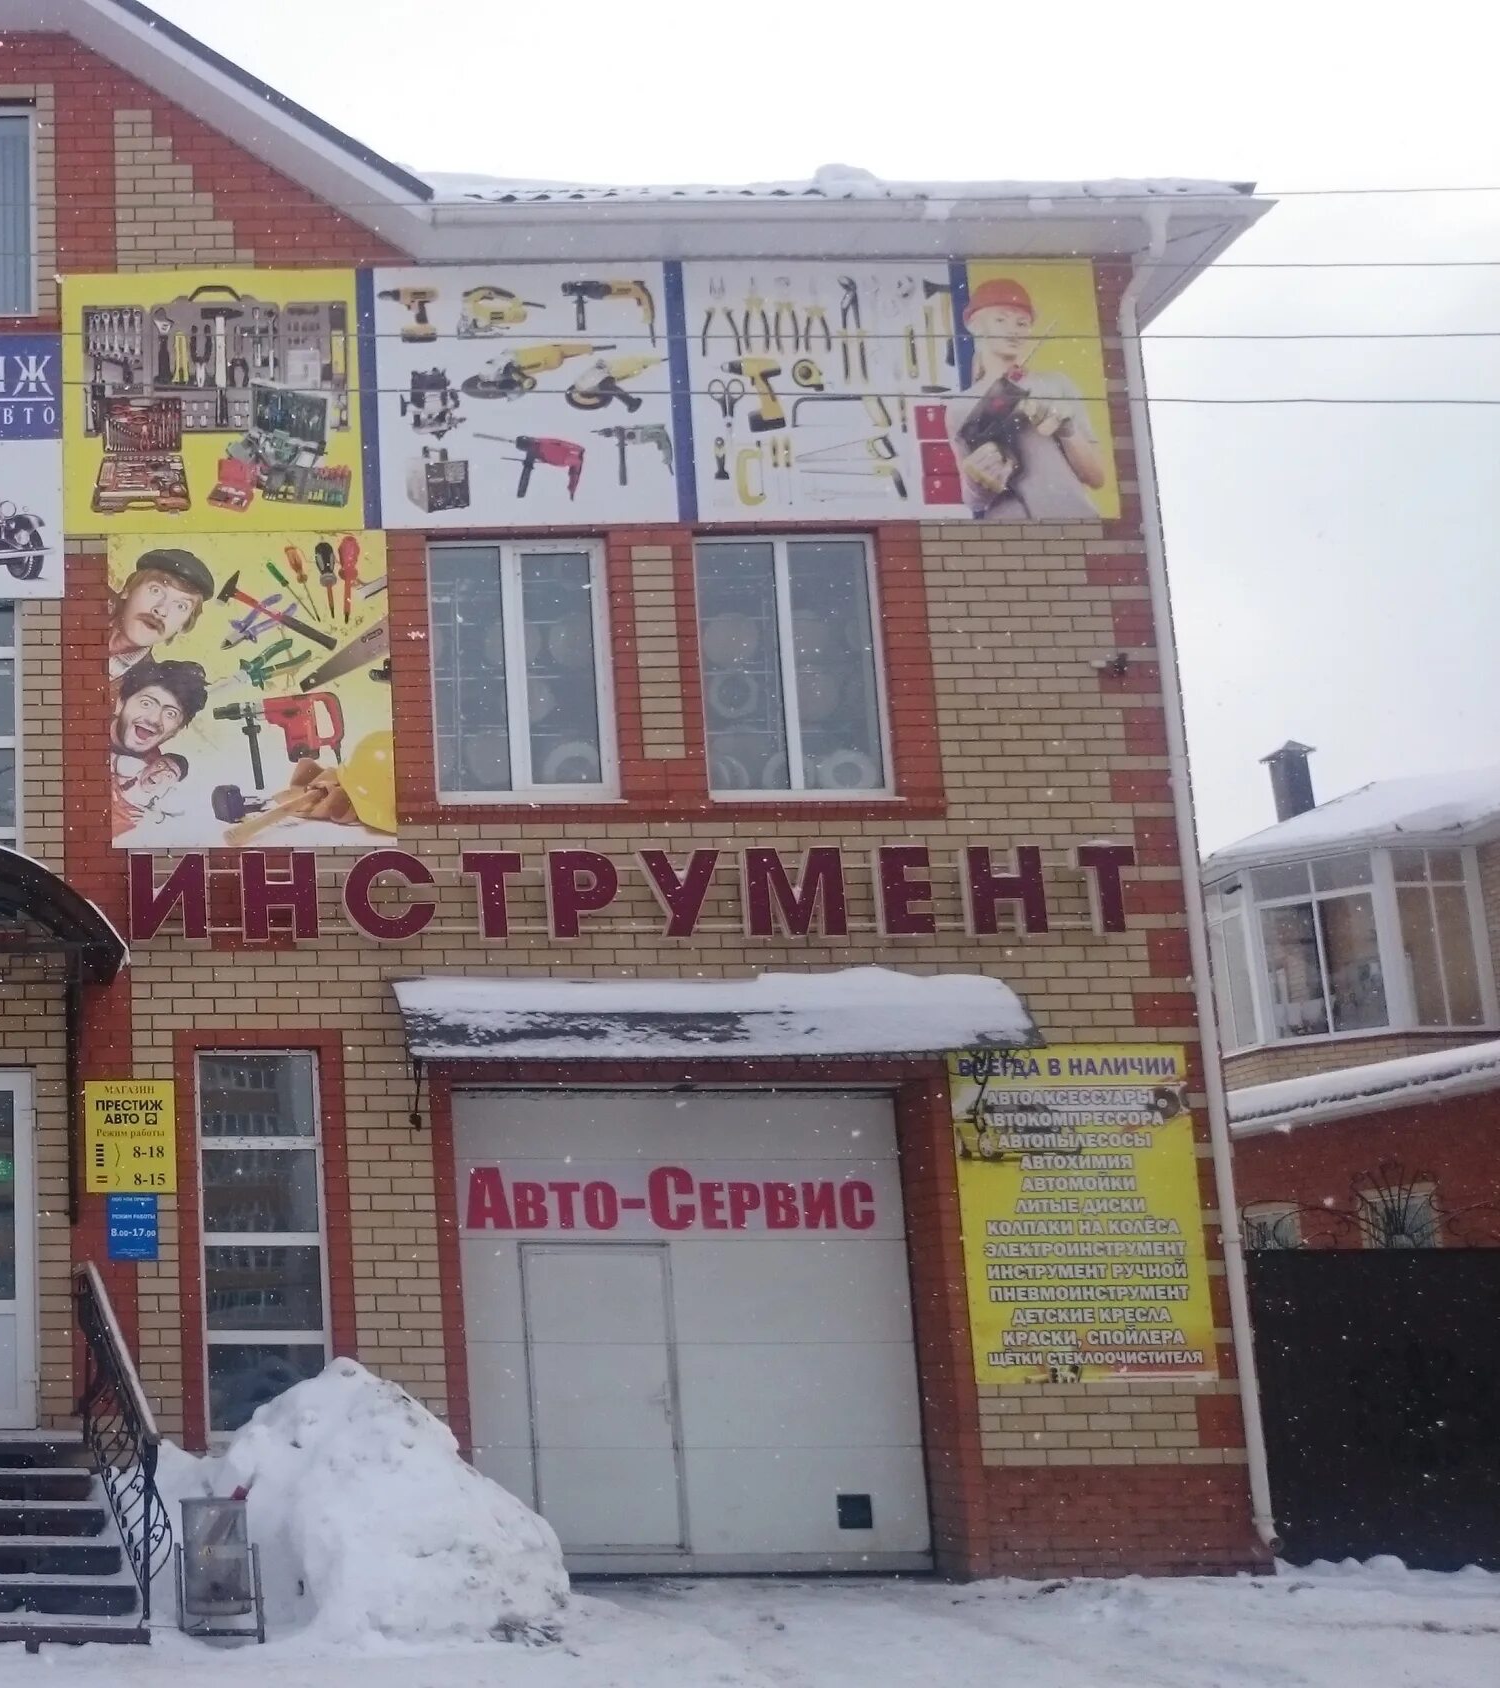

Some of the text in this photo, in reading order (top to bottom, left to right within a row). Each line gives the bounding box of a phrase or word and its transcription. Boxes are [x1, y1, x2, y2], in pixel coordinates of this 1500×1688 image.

[129, 843, 1136, 942] ИНСТРУМЕНТ
[1047, 1057, 1062, 1076] В
[1068, 1057, 1177, 1076] НАЛИЧИИ
[104, 1085, 155, 1094] МАГАЗИН
[986, 1089, 1155, 1106] АВТОАКСЕССУАРЫ
[95, 1099, 164, 1111] ПРЕСТИЖ
[104, 1113, 140, 1125] АВТО
[983, 1111, 1164, 1128] АВТОКОМПРЕССОРА
[96, 1128, 165, 1139] Режим работы
[998, 1132, 1153, 1149] АВТОПЫЛЕСОСЫ
[133, 1145, 165, 1159] 8-18
[1019, 1153, 1134, 1171] АВТОХИМИЯ
[134, 1173, 166, 1186] 8-15
[1021, 1171, 1137, 1193] АВТОМОЙКИ
[1014, 1197, 1147, 1217] ЛИТЫЕ ДИСКИ
[110, 1228, 157, 1238] 8.00-17.00
[986, 1220, 1073, 1237] КОЛПАКИ
[1078, 1219, 1103, 1236] НА
[984, 1240, 1187, 1258] ЭЛЕКТРОИНСТРУМЕНТ
[986, 1258, 1188, 1280] ИНСТРУМЕНТ РУЧНОЙ
[989, 1285, 1189, 1303] ПНЕВМОИНСТРУМЕНТ
[1011, 1307, 1172, 1327] ДЕТСКИЕ КРЕСЛА
[1002, 1325, 1185, 1348] КРАСКИ, СПОЙЛЕРА
[1046, 1350, 1204, 1366] СТЕКЛООЧИСТИТЕЛЯ
